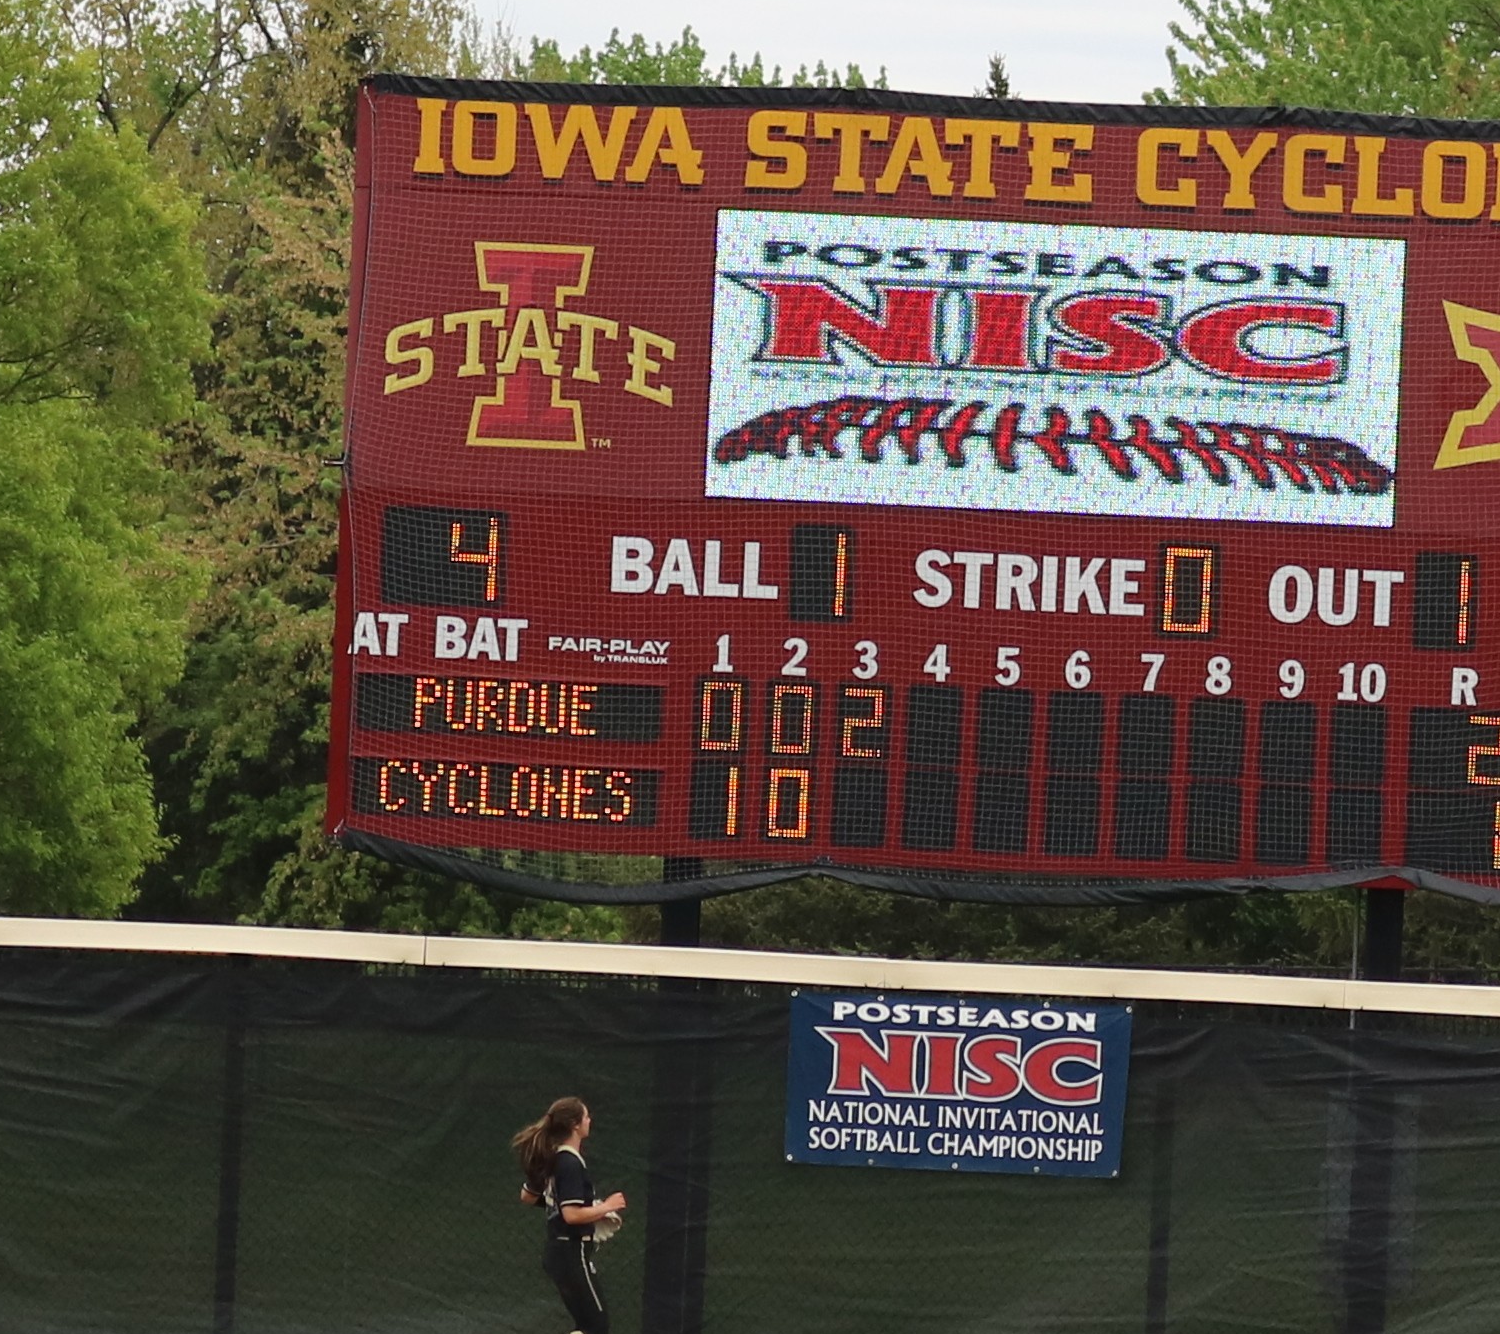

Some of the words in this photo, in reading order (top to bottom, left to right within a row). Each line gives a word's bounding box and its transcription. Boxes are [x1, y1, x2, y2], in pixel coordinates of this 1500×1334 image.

[413, 97, 704, 189] IOWA
[744, 109, 1094, 202] STATE
[763, 240, 1329, 287] POSTSEASON
[383, 308, 677, 408] STATE
[722, 272, 1346, 385] NISC
[590, 437, 612, 449] TM
[450, 517, 499, 602] 4
[610, 536, 779, 599] BALL
[832, 532, 846, 617] 1
[912, 549, 1147, 617] STRIKE
[1162, 546, 1213, 633] 0
[1267, 565, 1404, 627] OUT
[1457, 560, 1470, 644] 1
[347, 612, 409, 656] AT
[434, 615, 529, 662] BAT
[548, 636, 671, 655] FAIR-PLAY
[593, 653, 607, 663] by
[715, 635, 733, 673] 1
[782, 637, 808, 677] 2
[852, 641, 879, 679] 3
[922, 644, 951, 683] 4
[996, 647, 1021, 686] 5
[1065, 650, 1091, 689] 6
[1140, 653, 1165, 692] 7
[1204, 655, 1232, 696] 8
[1278, 659, 1306, 700] 9
[1337, 662, 1387, 703] 10
[1451, 667, 1479, 707] R
[413, 677, 598, 736] PURDUE
[701, 680, 743, 751] 0
[772, 683, 813, 755] 0
[842, 687, 884, 759] 2
[378, 760, 632, 822] CYCLONES
[725, 766, 738, 837] 1
[768, 768, 809, 838] 0
[833, 1000, 1097, 1033] POSTSEASON
[814, 1026, 1104, 1107] NISC
[808, 1100, 931, 1128] NATIONAL
[937, 1105, 1104, 1136] INVITATIONAL
[808, 1126, 921, 1155] SOFTBALL
[927, 1132, 1103, 1162] CHAMPIONSHIP
